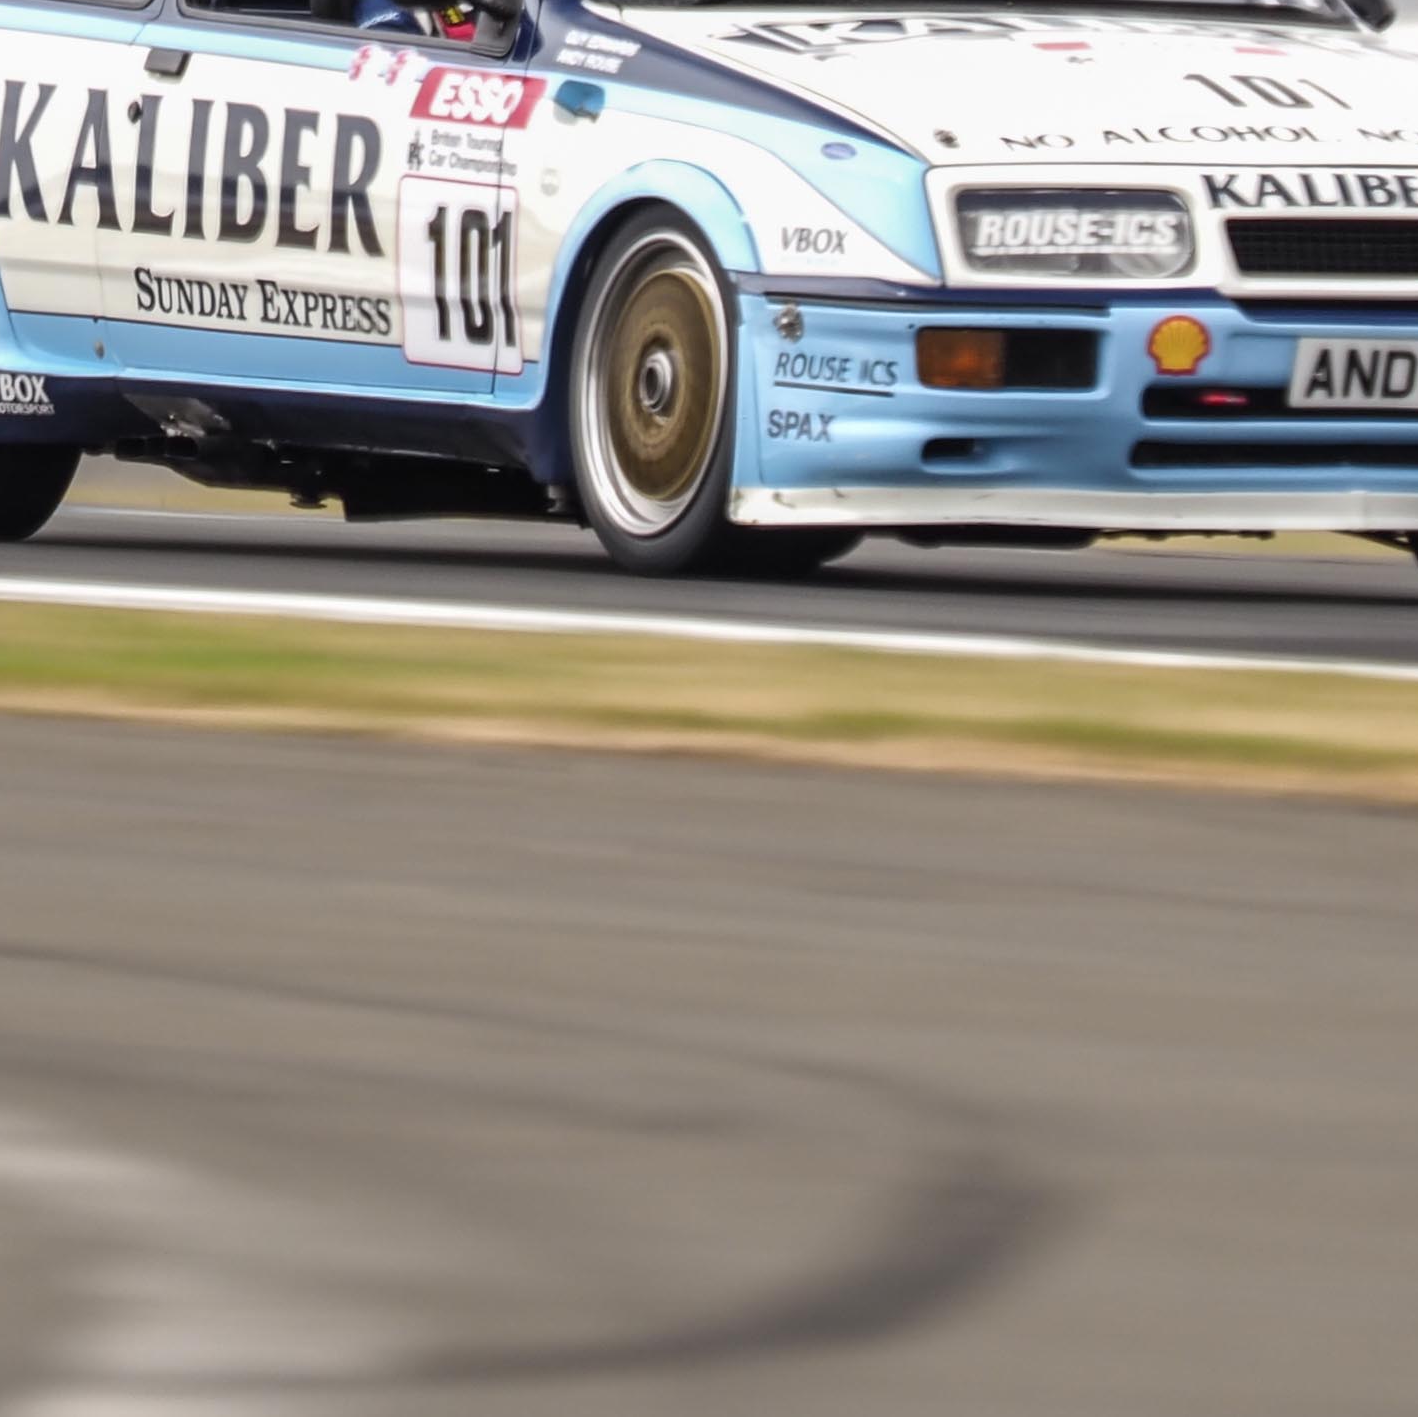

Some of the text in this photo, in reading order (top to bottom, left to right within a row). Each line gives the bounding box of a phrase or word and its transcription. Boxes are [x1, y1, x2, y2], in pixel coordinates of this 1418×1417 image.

[429, 72, 524, 124] ESSO
[1182, 73, 1352, 110] 101
[428, 149, 447, 167] Car
[998, 133, 1075, 149] NO
[781, 227, 848, 254] VBOX
[428, 204, 517, 348] 101
[133, 266, 394, 337] SUNDAY EXPRESS
[774, 351, 852, 383] ROUSE
[767, 408, 836, 443] SPAX
